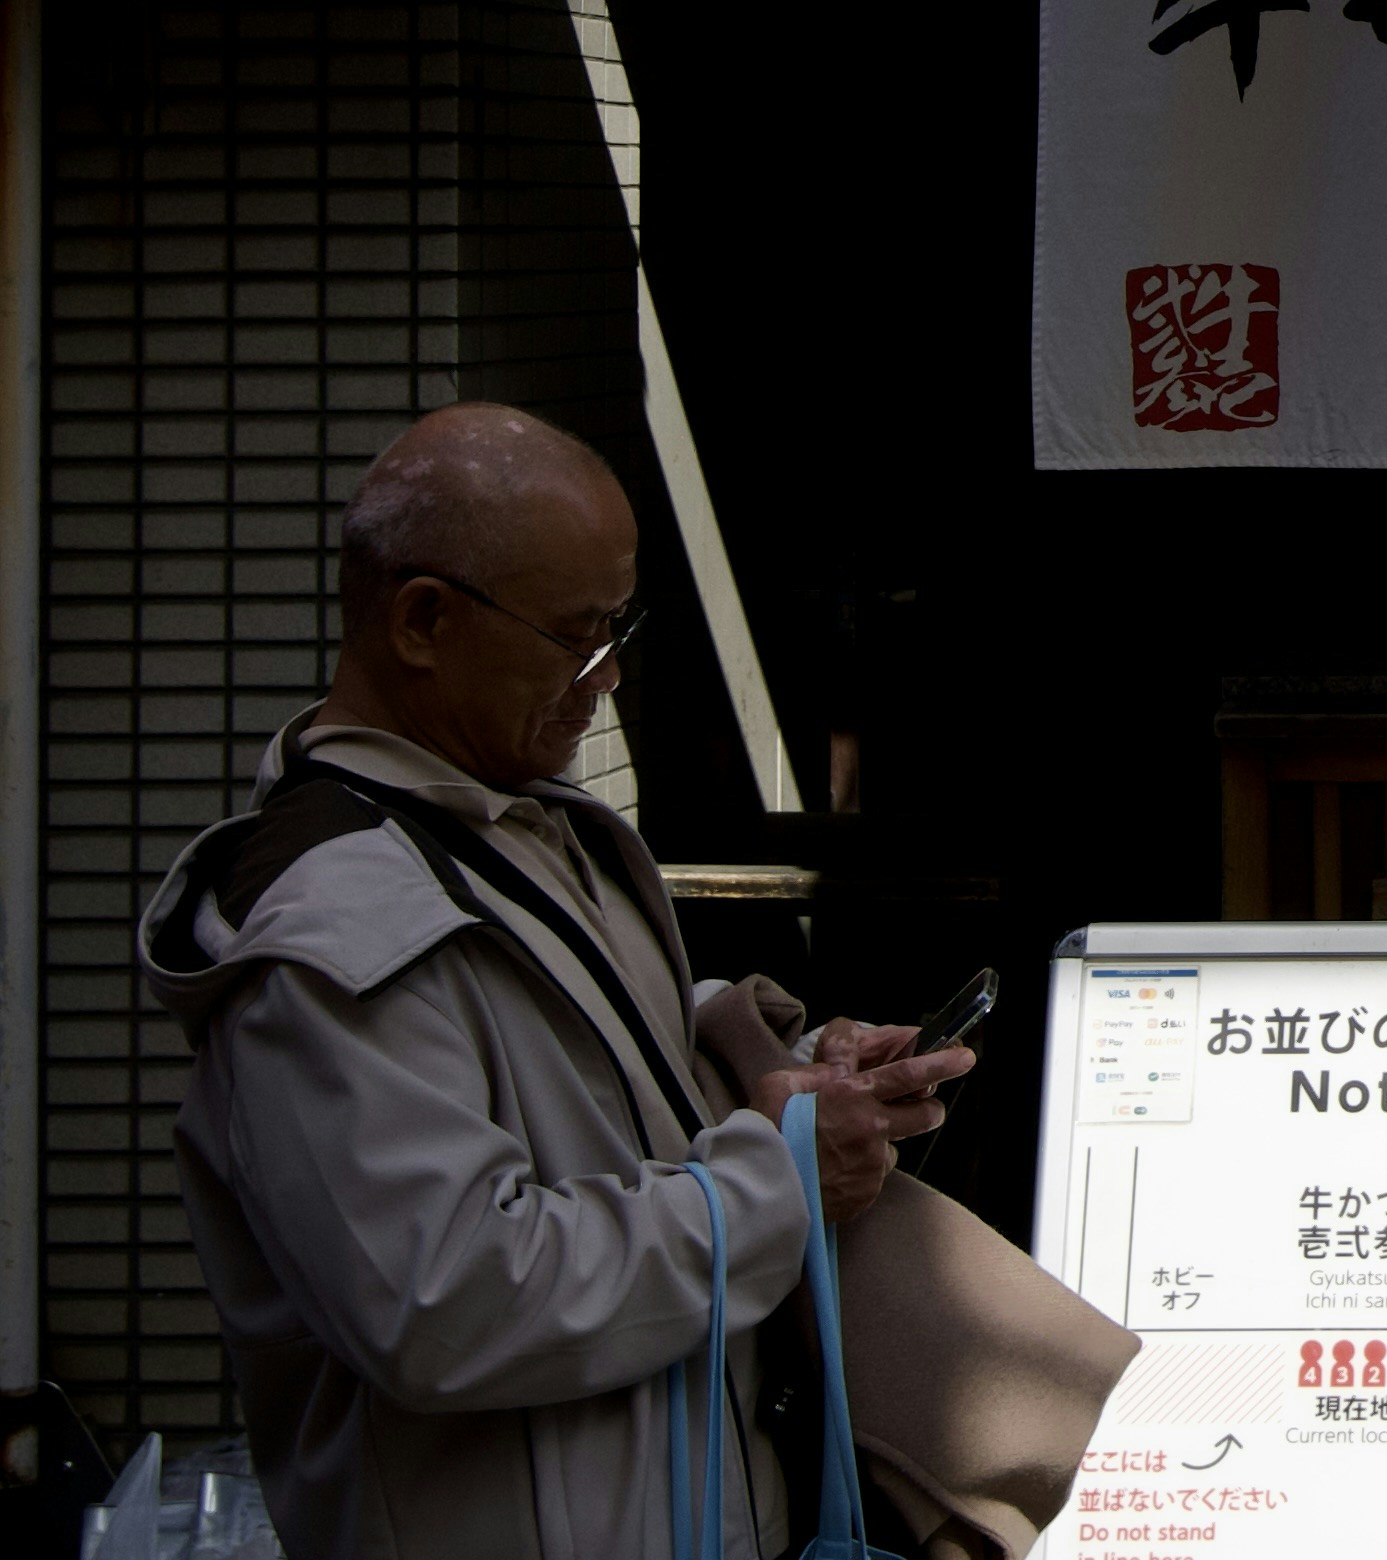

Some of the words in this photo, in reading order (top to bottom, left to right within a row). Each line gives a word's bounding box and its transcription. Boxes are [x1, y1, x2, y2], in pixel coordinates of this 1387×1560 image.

[1107, 989, 1131, 999] VISA
[1152, 1266, 1214, 1287] ホビー
[1162, 1291, 1201, 1310] オフ
[1306, 1293, 1336, 1308] Ichi
[1343, 1294, 1358, 1308] ni
[1304, 1367, 1316, 1383] 4
[1336, 1367, 1348, 1383] 3
[1369, 1367, 1380, 1383] 2
[1285, 1427, 1353, 1444] Current
[1080, 1450, 1167, 1472] ここには
[1078, 1487, 1288, 1512] 並ばないでください
[1079, 1523, 1109, 1542] Do
[1116, 1524, 1150, 1541] not
[1157, 1522, 1216, 1541] stand
